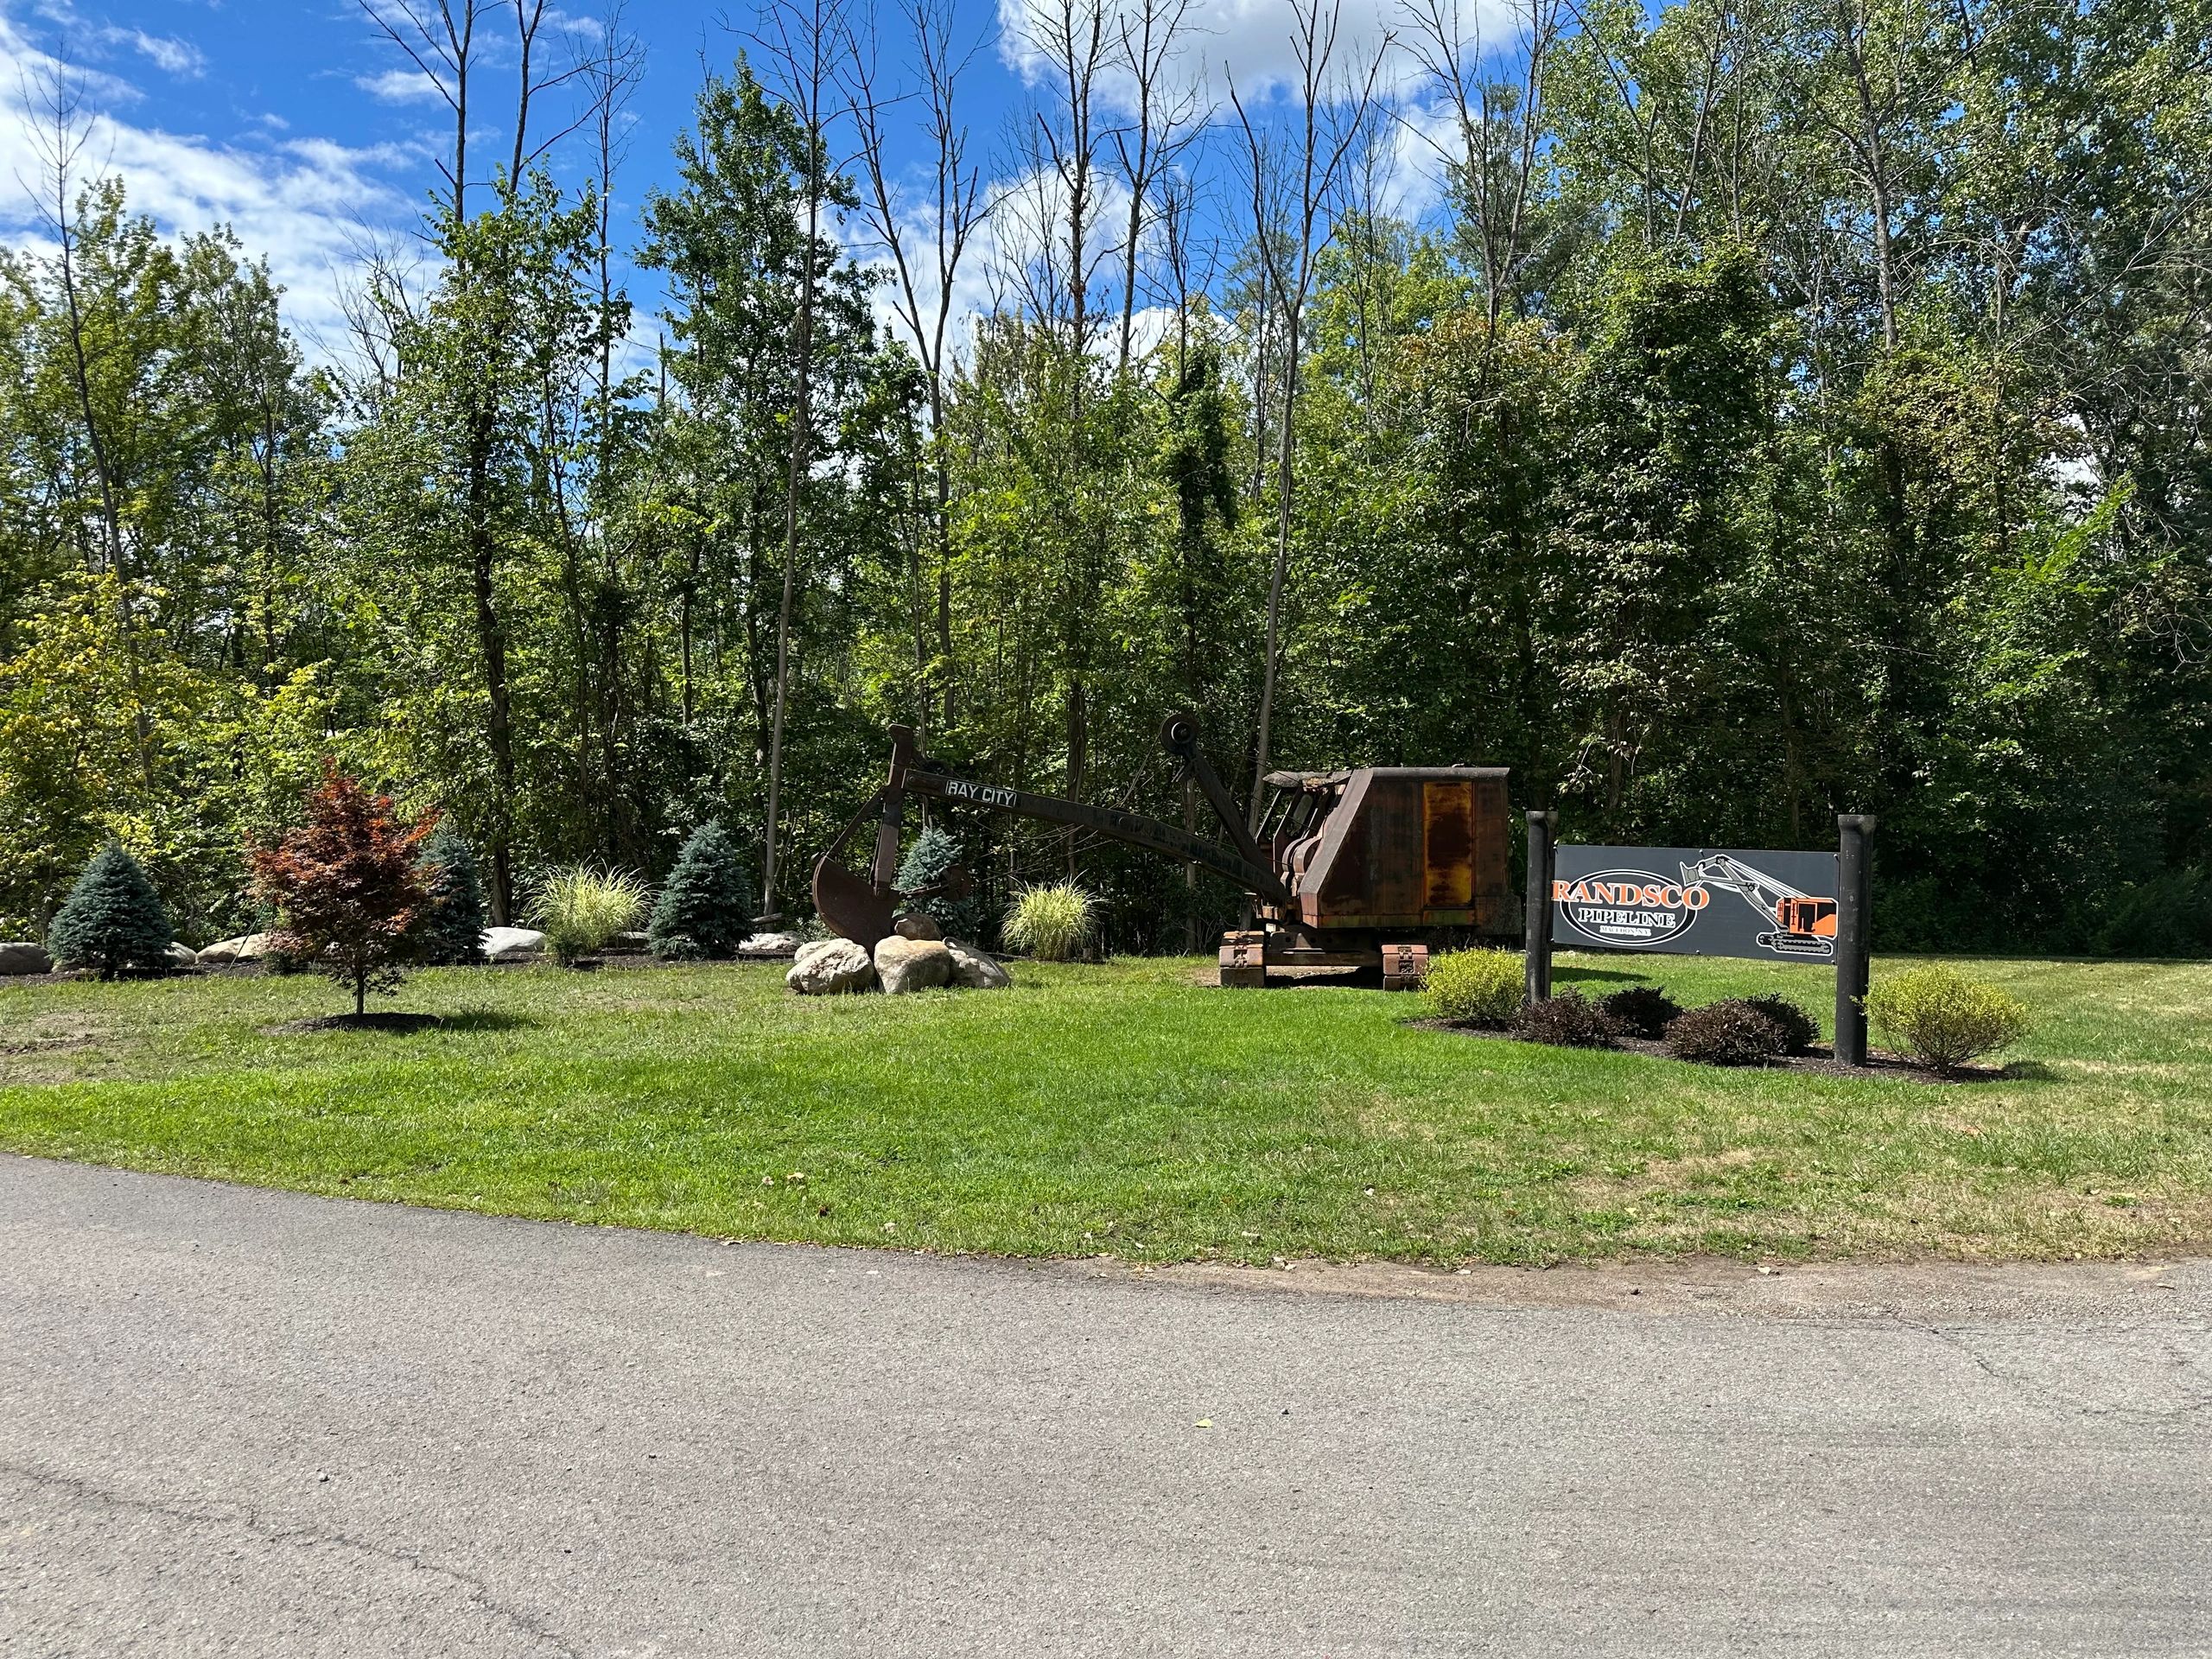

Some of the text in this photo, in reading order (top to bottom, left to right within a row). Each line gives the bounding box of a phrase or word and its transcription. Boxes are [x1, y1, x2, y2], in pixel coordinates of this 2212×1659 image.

[982, 788, 1014, 805] CITY
[1552, 880, 1710, 910] RANDSCO
[1579, 908, 1676, 928] PIPELINE
